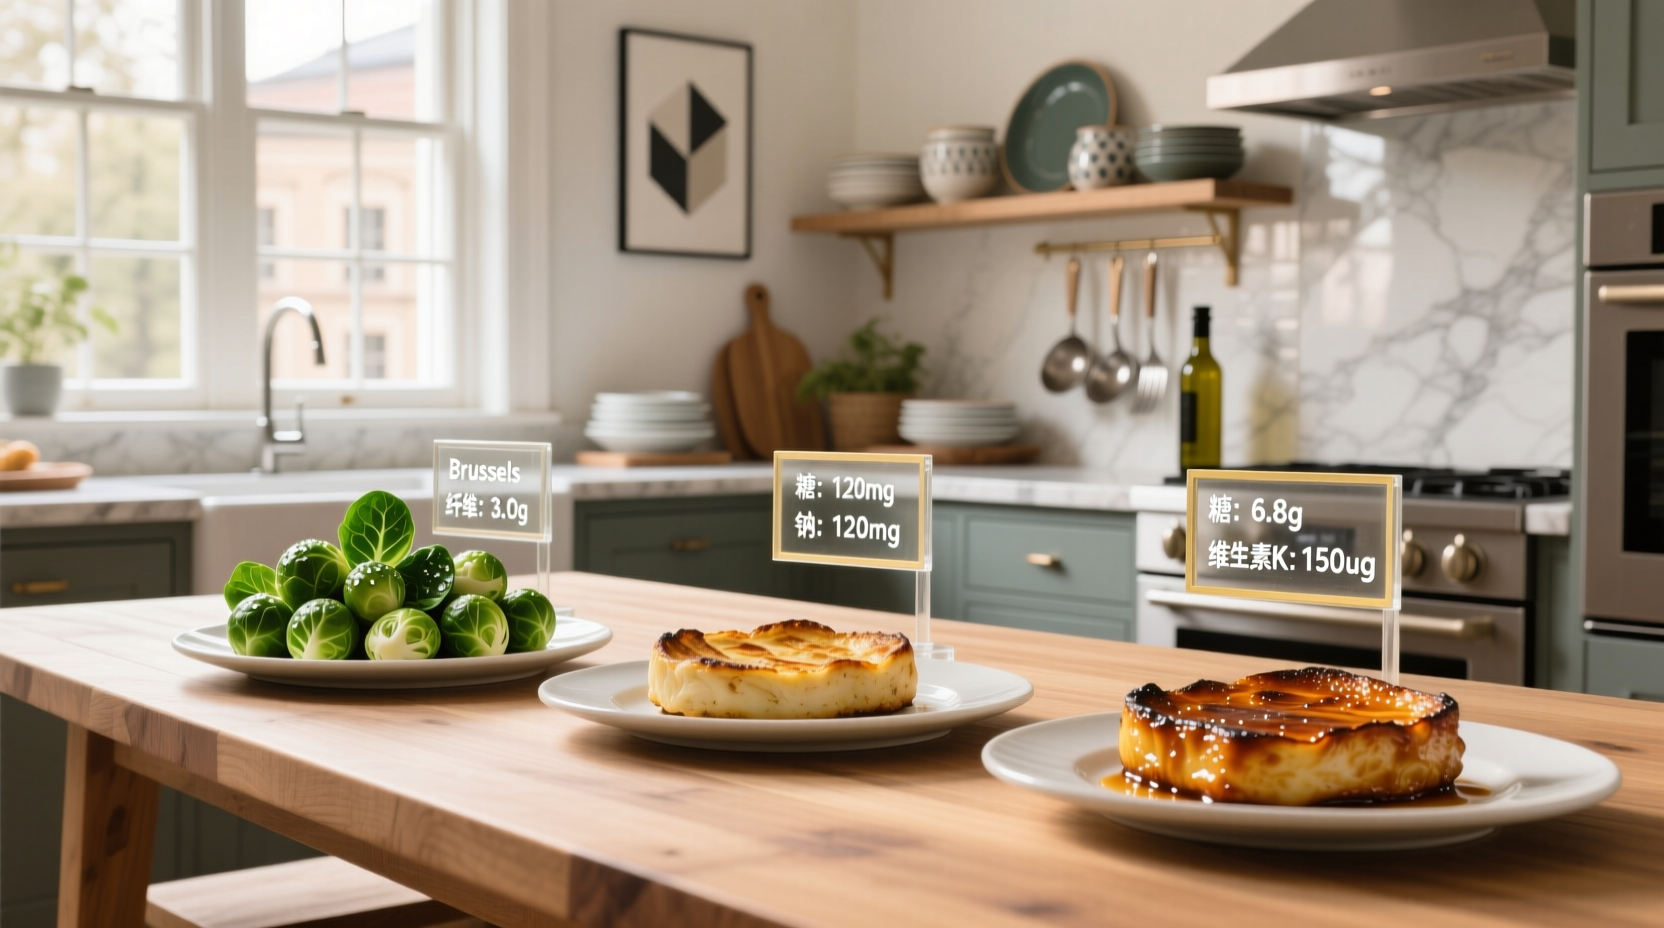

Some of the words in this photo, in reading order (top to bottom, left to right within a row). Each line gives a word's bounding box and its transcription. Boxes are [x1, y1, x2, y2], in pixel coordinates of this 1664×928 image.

[449, 458, 520, 483] Brussels
[795, 473, 822, 500] 糖:
[833, 476, 895, 507] 120mg
[491, 497, 528, 526] 3.0g
[1208, 494, 1240, 523] 糖:
[1252, 498, 1303, 531] 6.8g
[795, 511, 822, 539] 钠:
[833, 515, 900, 548] 120mg
[1302, 546, 1376, 583] 150ug
